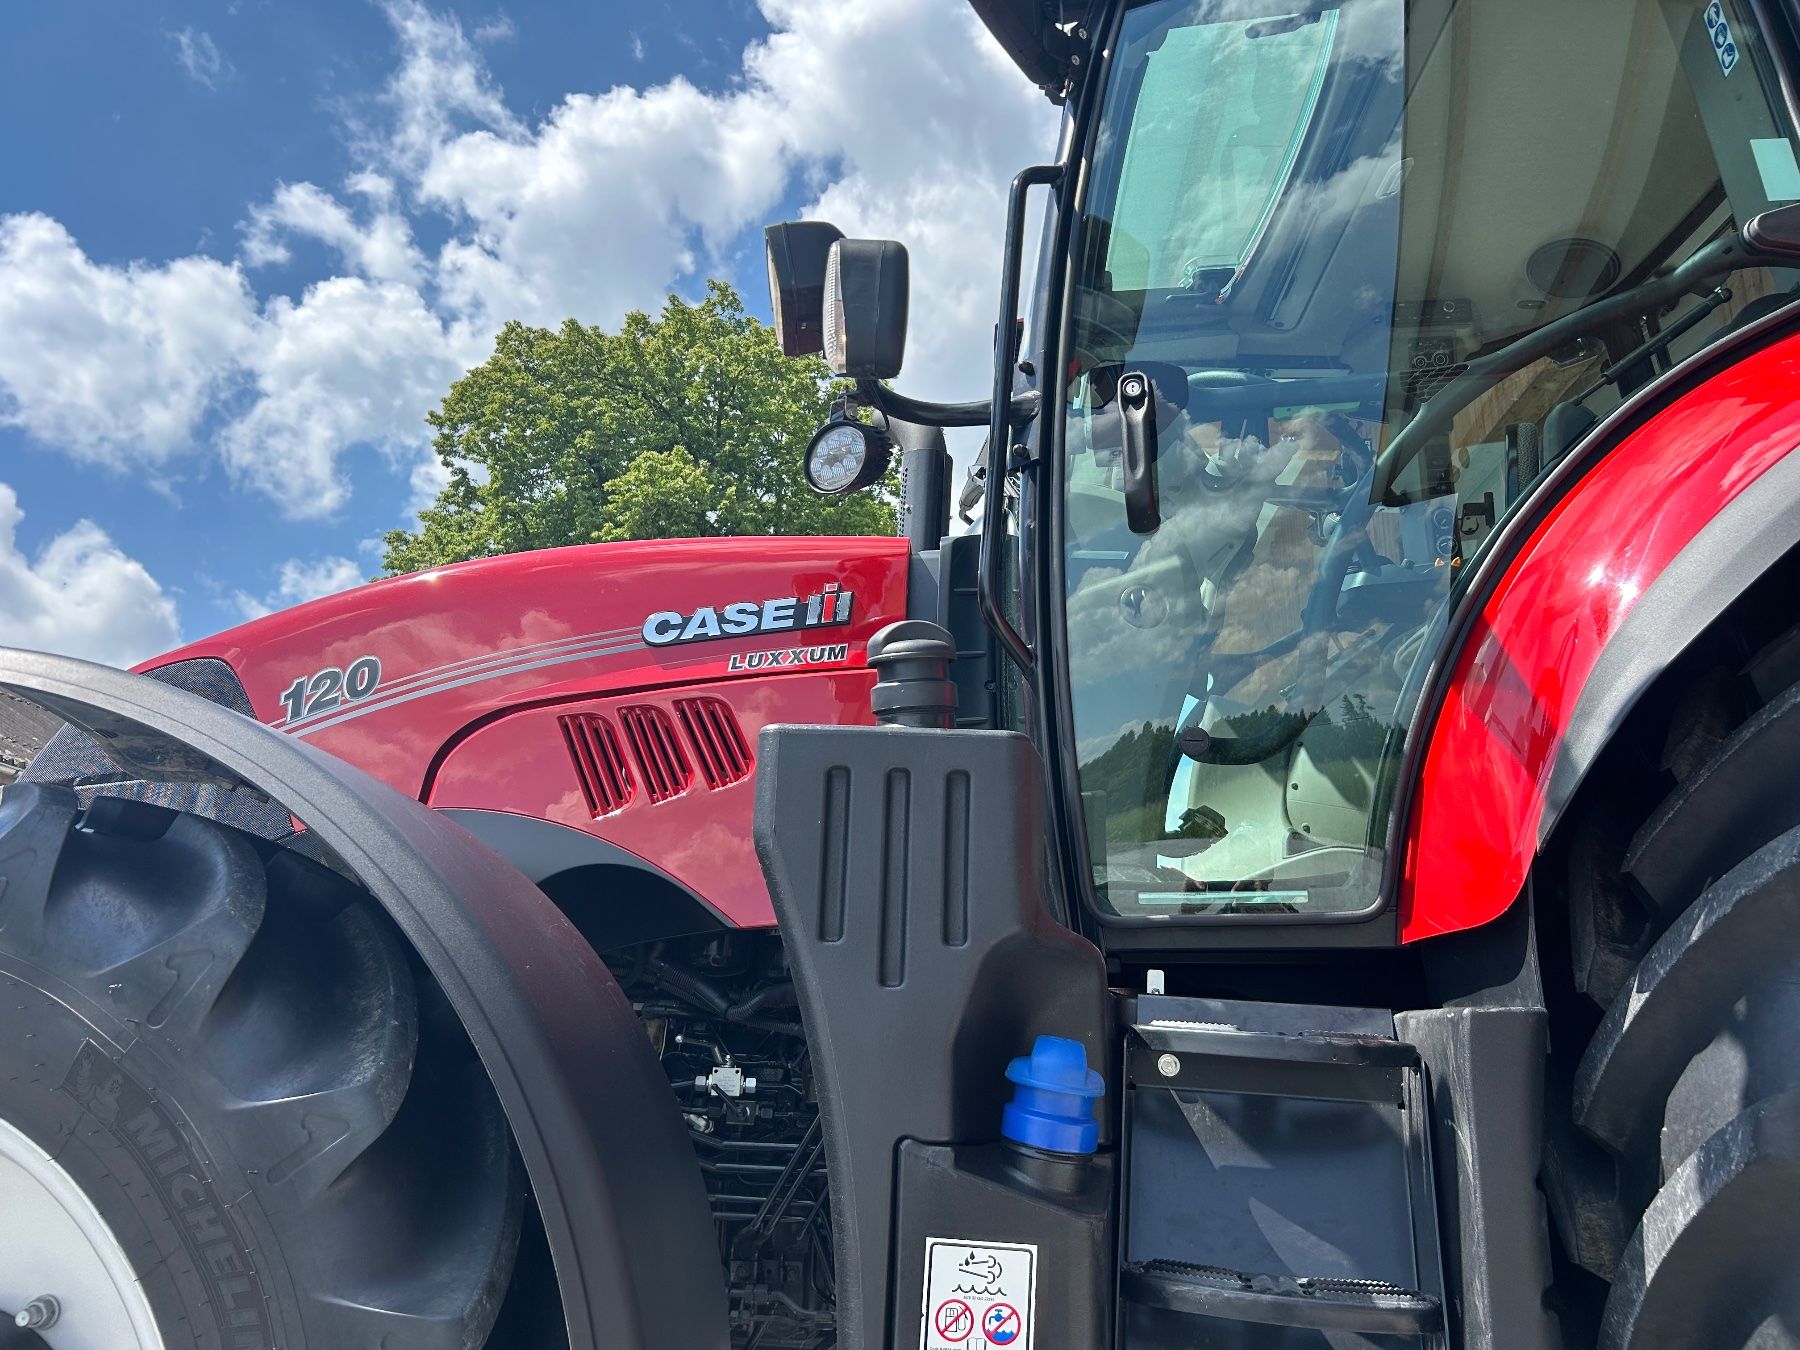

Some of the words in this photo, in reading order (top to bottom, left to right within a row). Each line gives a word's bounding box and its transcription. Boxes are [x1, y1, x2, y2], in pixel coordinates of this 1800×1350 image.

[642, 597, 799, 644] CASE
[728, 643, 849, 672] LUXXUM
[281, 656, 382, 724] 120
